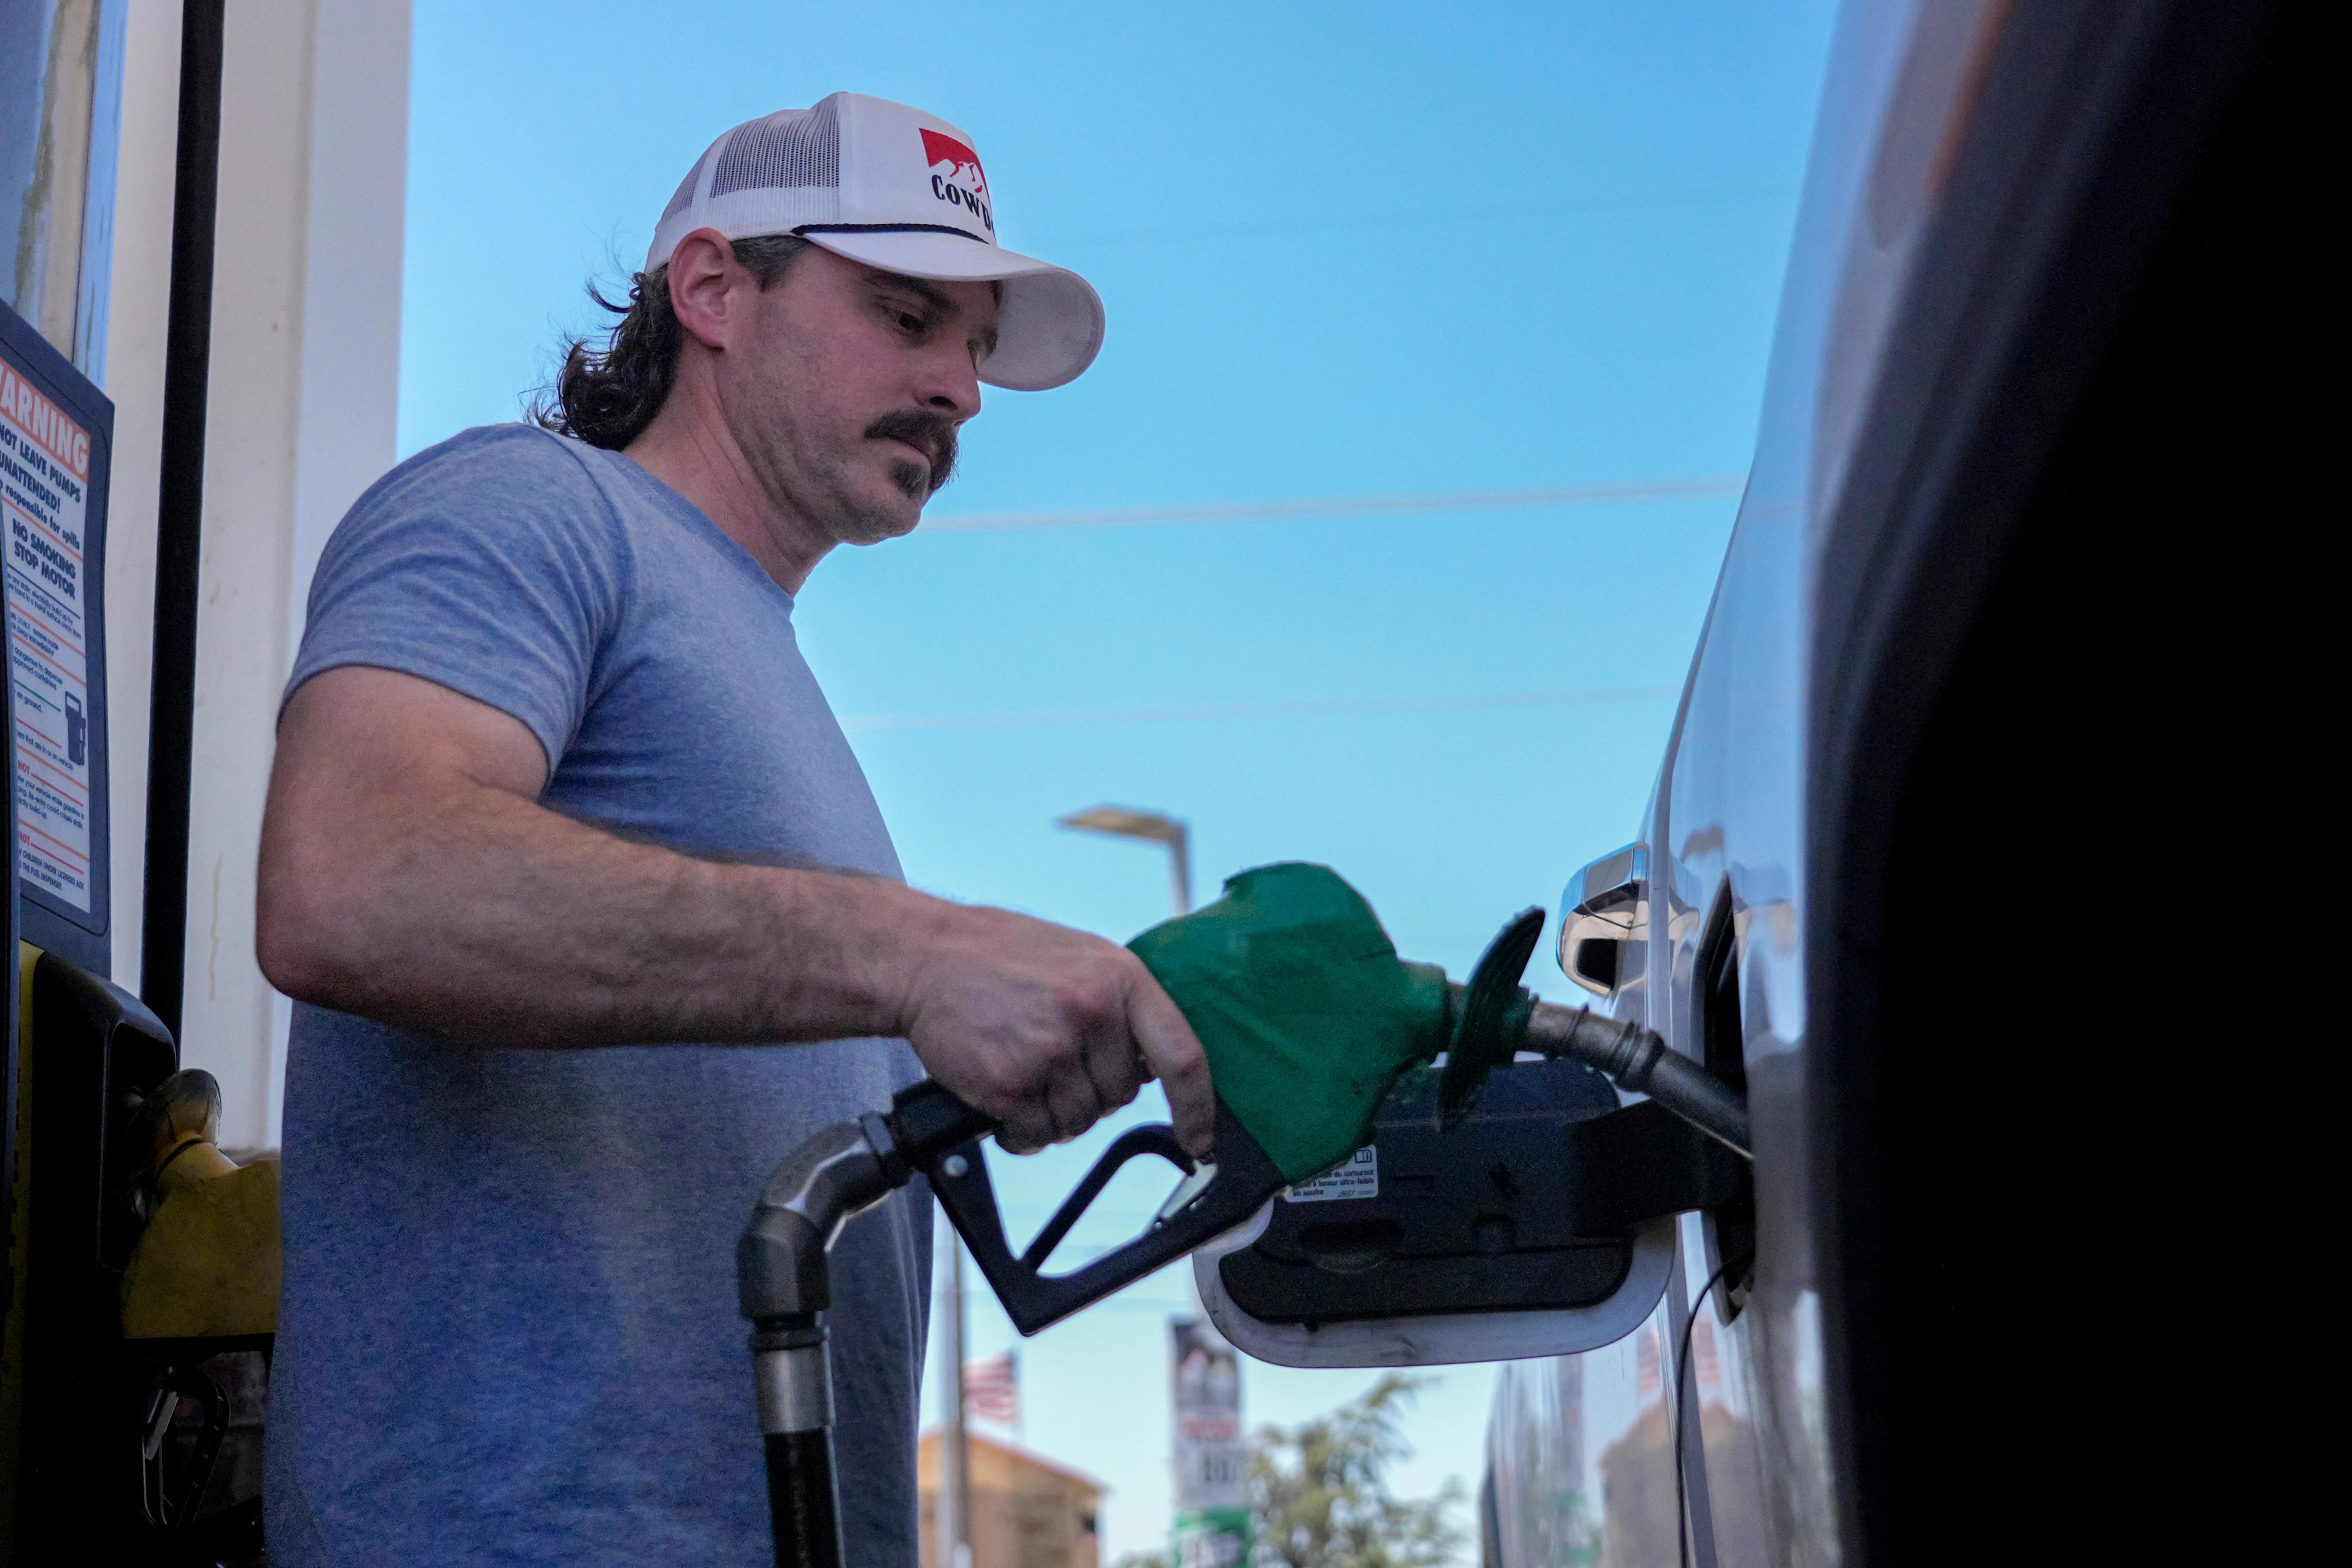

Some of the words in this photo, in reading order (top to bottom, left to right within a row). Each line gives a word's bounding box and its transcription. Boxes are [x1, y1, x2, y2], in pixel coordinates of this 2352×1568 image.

[20, 440, 46, 476] LEAVE
[50, 465, 81, 503] PUMPS
[6, 484, 47, 524] responsible
[50, 516, 60, 533] for
[62, 530, 80, 550] spills
[13, 518, 28, 542] NO
[31, 533, 75, 579] SMOKING
[15, 541, 38, 569] STOP
[41, 561, 75, 599] MOTOR
[18, 760, 30, 774] NOT
[23, 850, 42, 867] CHILDREN
